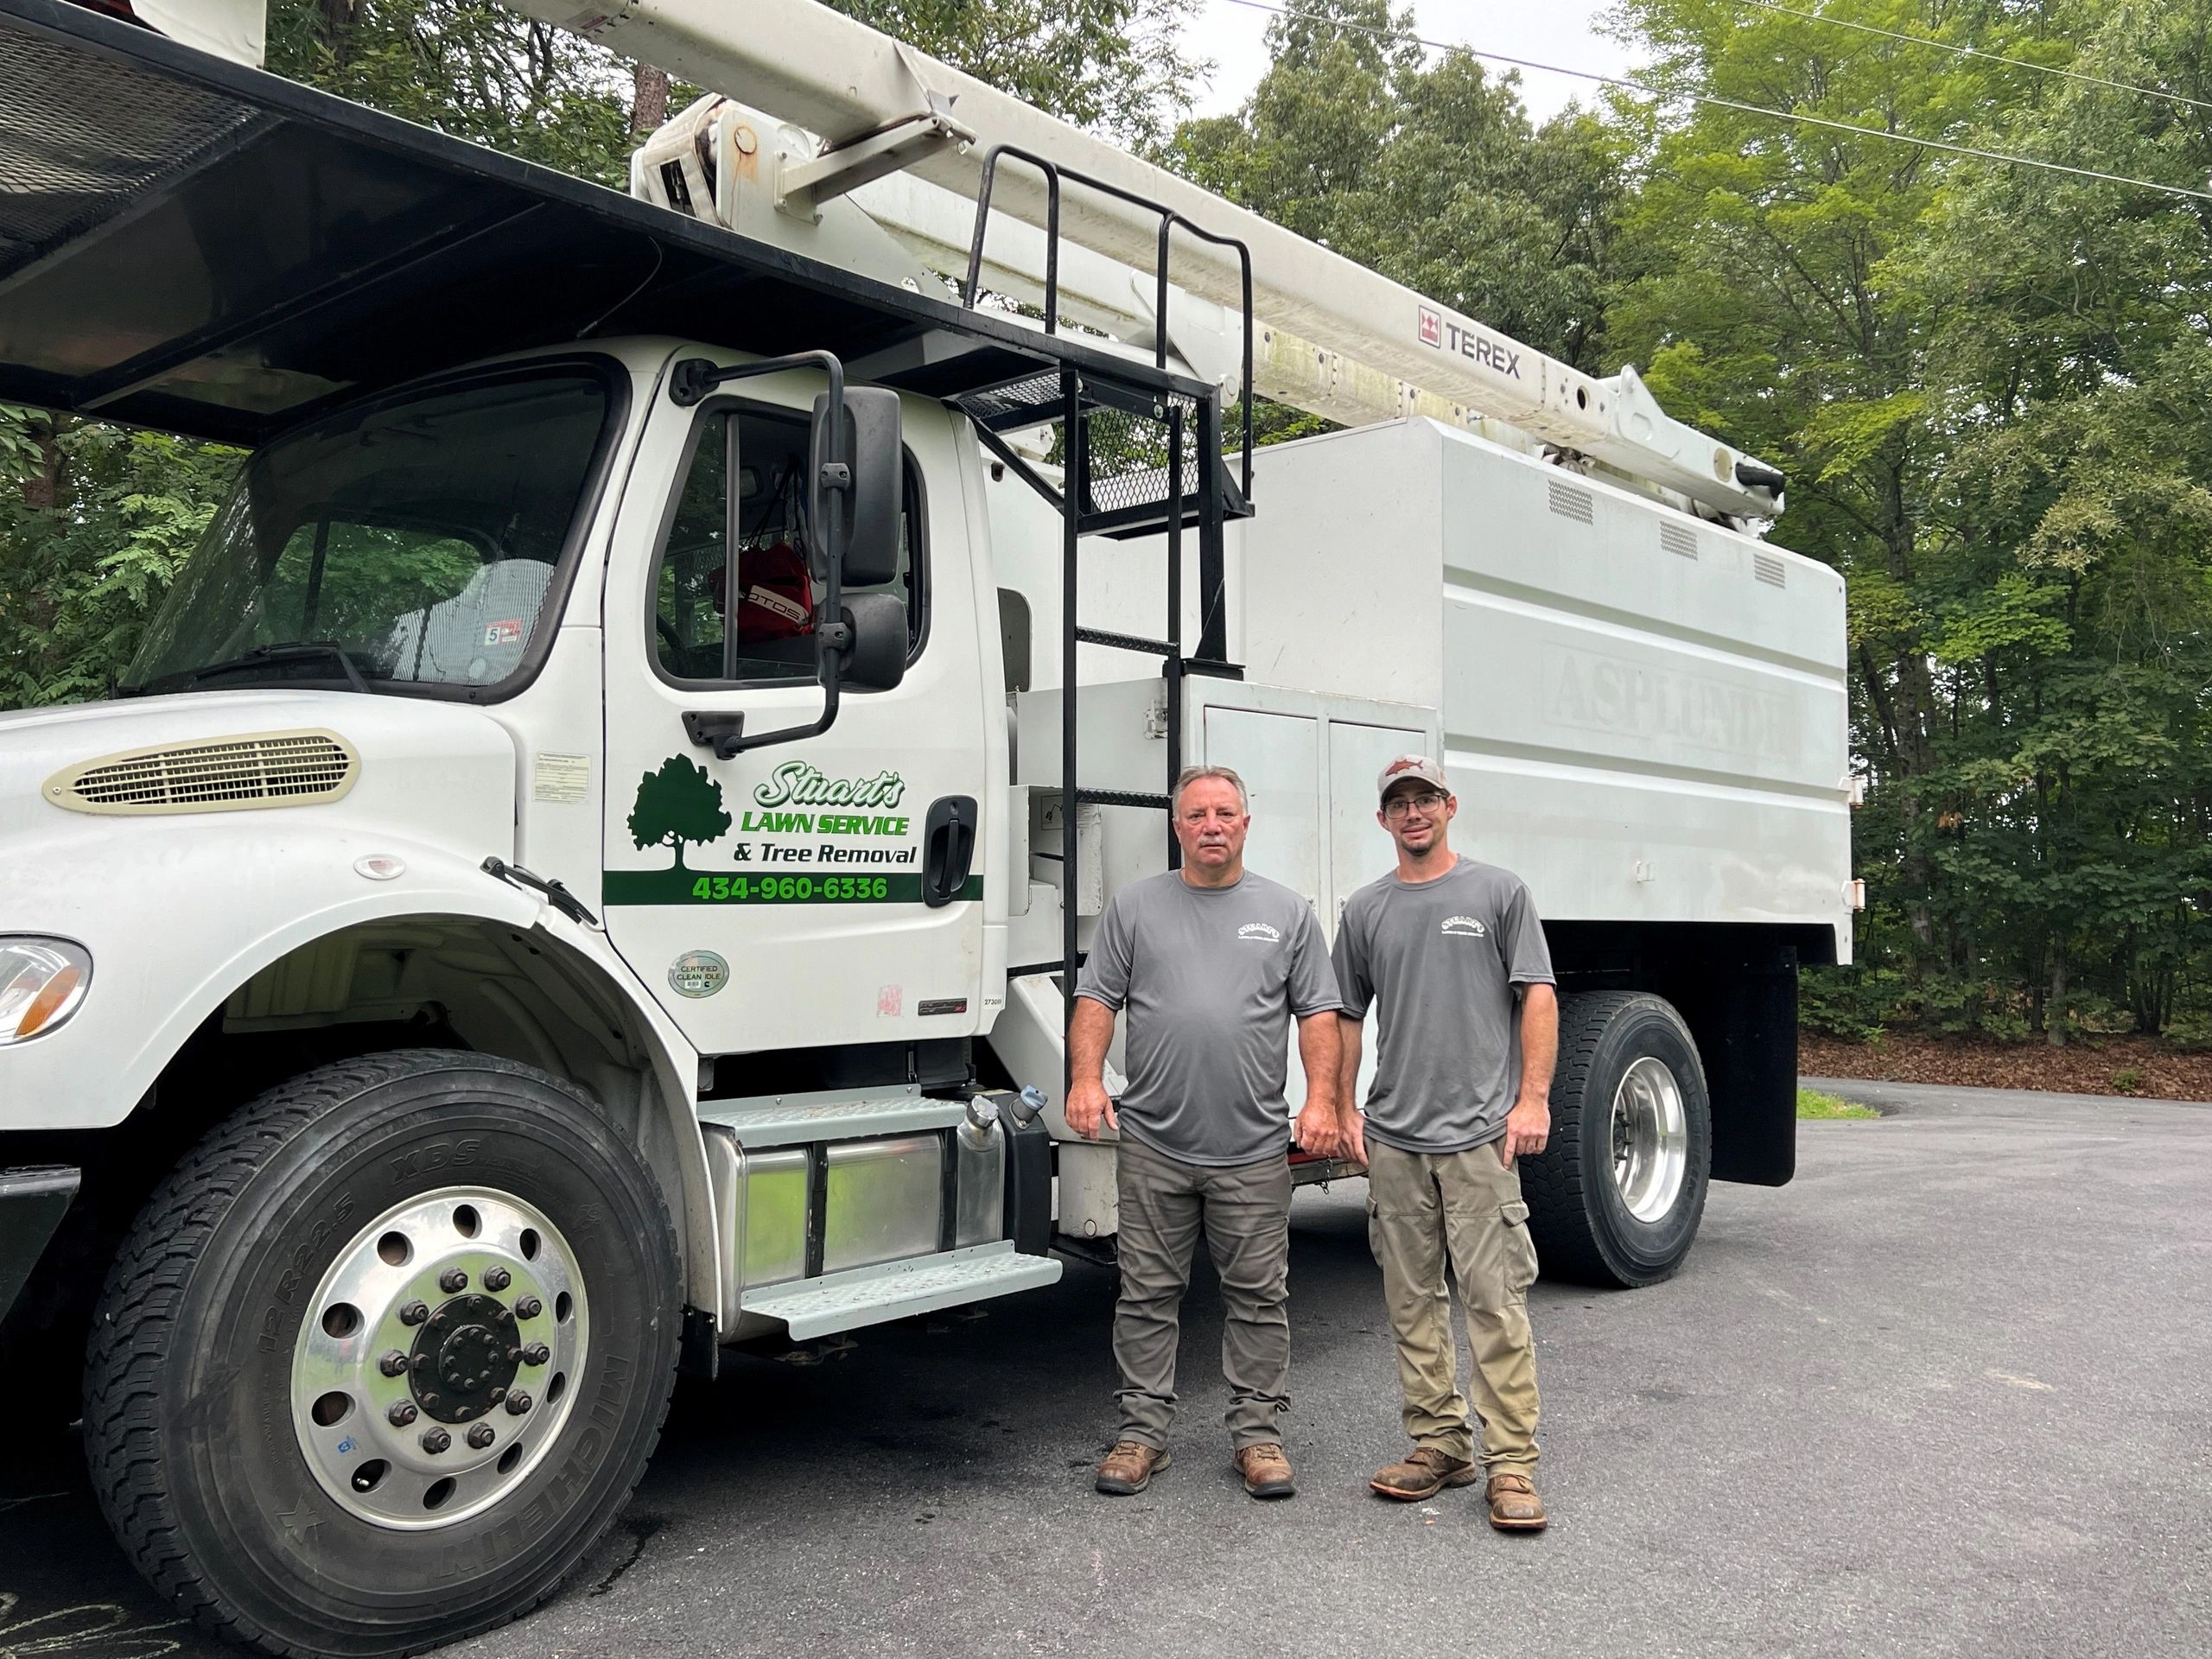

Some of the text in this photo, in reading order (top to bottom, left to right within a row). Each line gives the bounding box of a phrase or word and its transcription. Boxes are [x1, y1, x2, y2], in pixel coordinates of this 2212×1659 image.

[1446, 322, 1521, 380] TEREX
[489, 628, 498, 641] 5
[753, 760, 906, 809] Stuart's
[741, 811, 910, 836] LAWN SERVICE
[734, 842, 917, 863] & Tree Removal
[692, 876, 887, 900] 434-960-6336
[391, 1139, 480, 1185] XDS
[435, 1354, 630, 1579] MICHELIN
